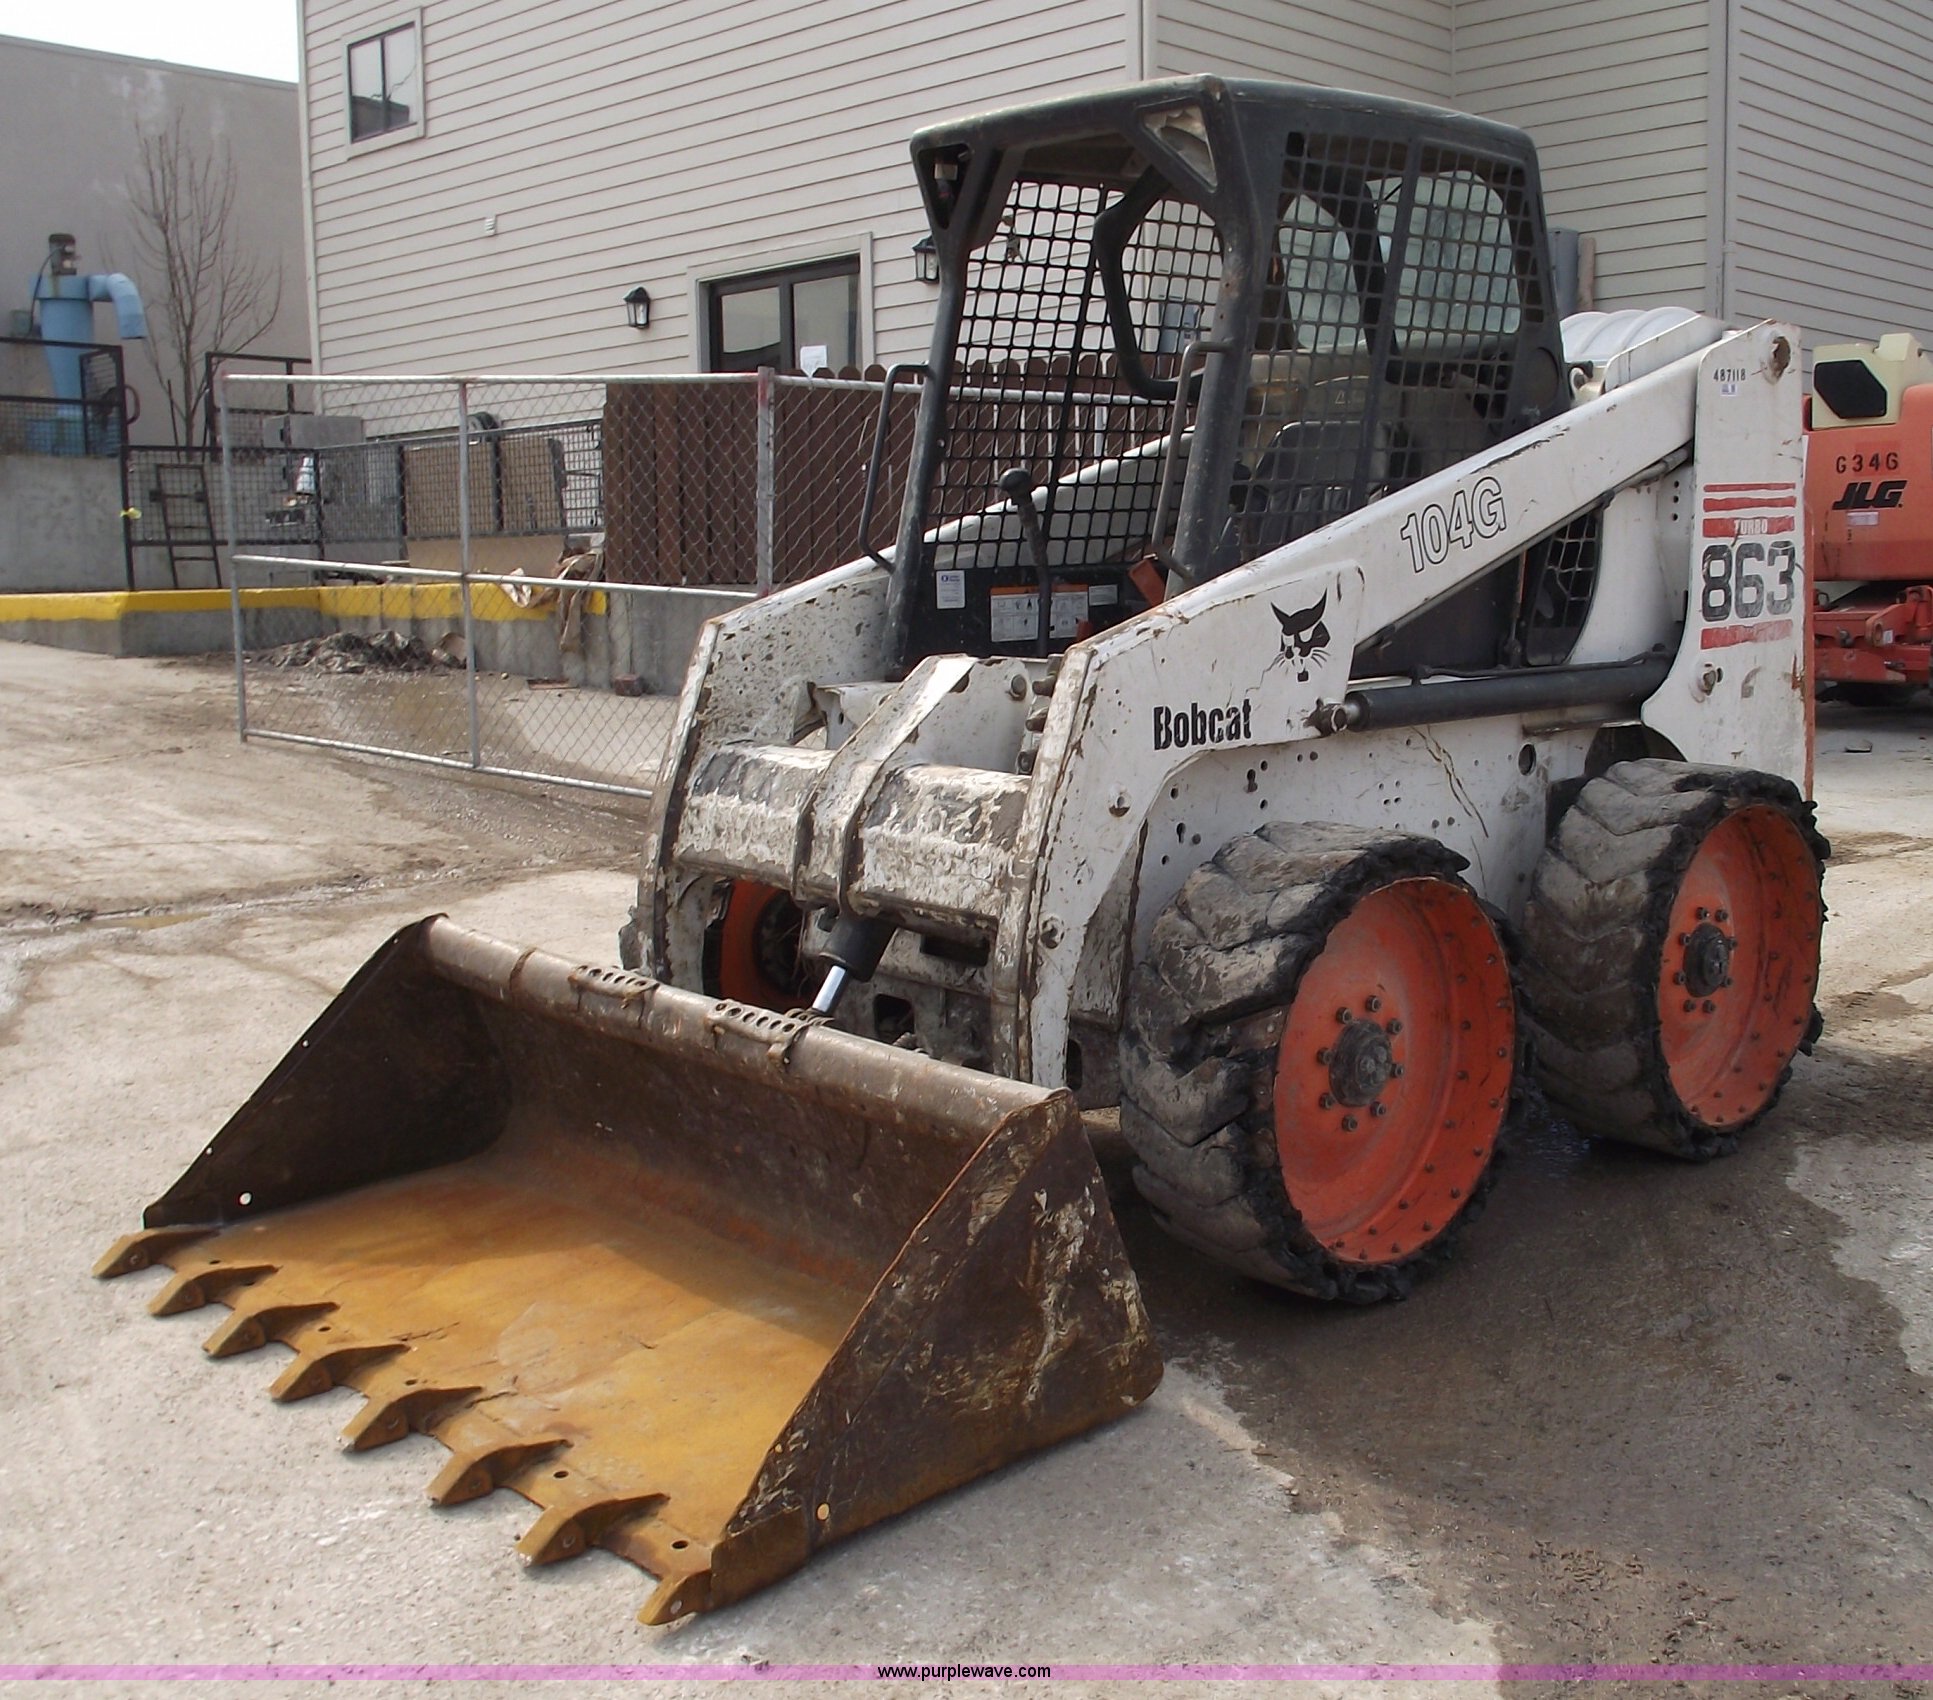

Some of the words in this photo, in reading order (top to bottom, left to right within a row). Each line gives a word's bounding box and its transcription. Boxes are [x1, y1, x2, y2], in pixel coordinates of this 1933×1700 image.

[1713, 368, 1746, 382] 487118
[1832, 480, 1907, 510] JLG
[1400, 476, 1507, 573] 104G
[1734, 519, 1768, 534] TURBO
[1702, 541, 1796, 622] 863
[1154, 698, 1252, 750] Bobcat
